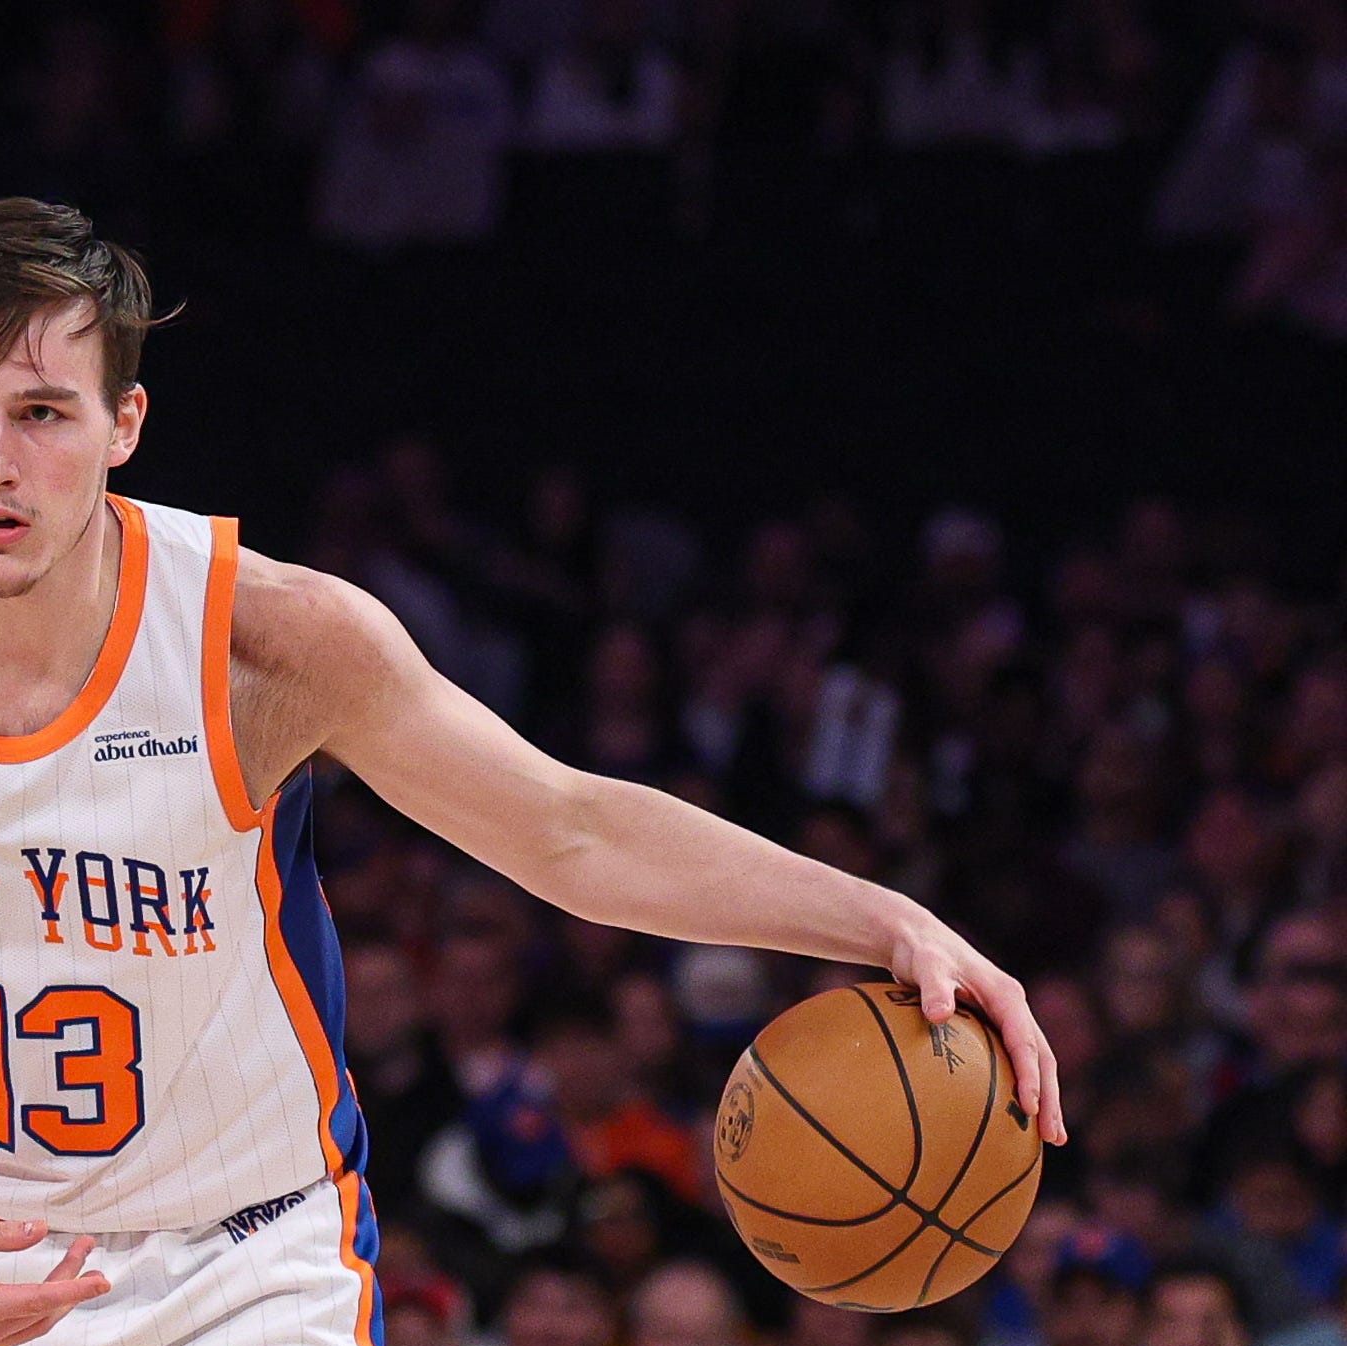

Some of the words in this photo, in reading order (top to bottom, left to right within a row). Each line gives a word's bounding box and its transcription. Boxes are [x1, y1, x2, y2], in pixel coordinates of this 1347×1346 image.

[94, 730, 151, 743] experience
[94, 743, 135, 762] abu
[20, 847, 217, 958] YORK
